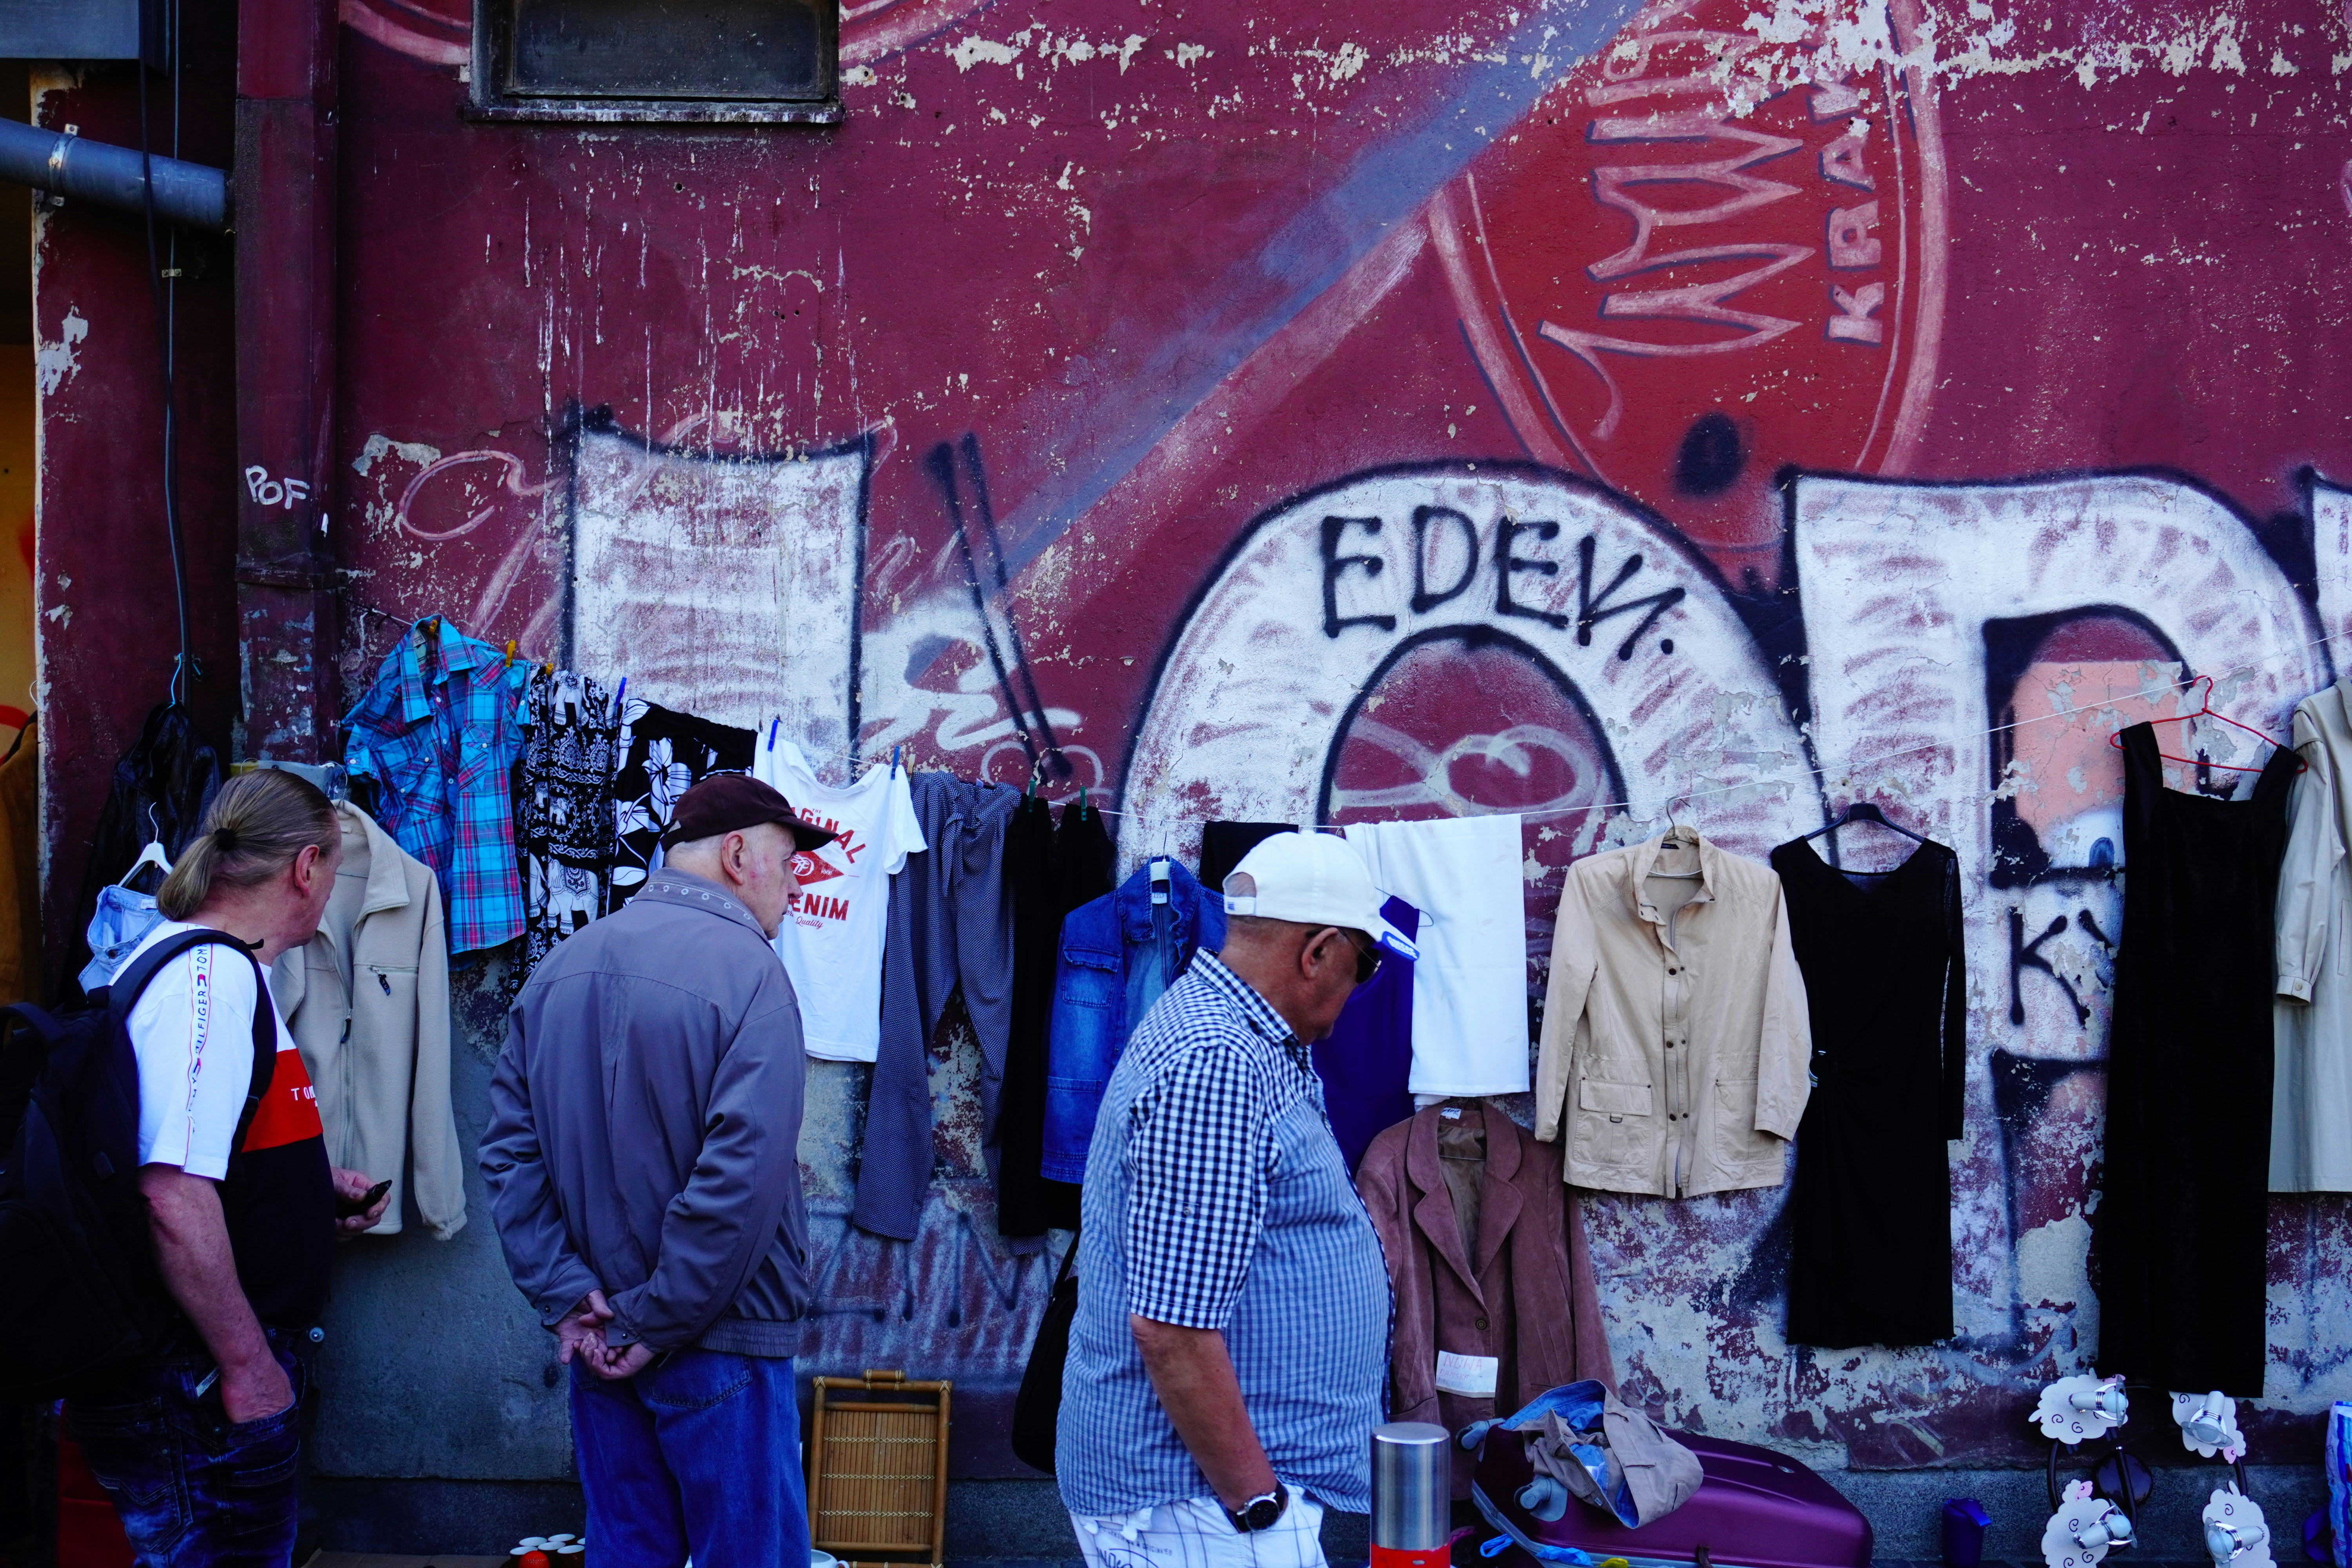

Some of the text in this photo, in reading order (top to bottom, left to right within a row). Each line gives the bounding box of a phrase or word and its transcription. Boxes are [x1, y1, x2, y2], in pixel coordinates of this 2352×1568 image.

[245, 465, 310, 510] POF
[788, 892, 849, 921] ENIM
[795, 916, 824, 929] Quality
[1443, 1354, 1482, 1372] NOWA
